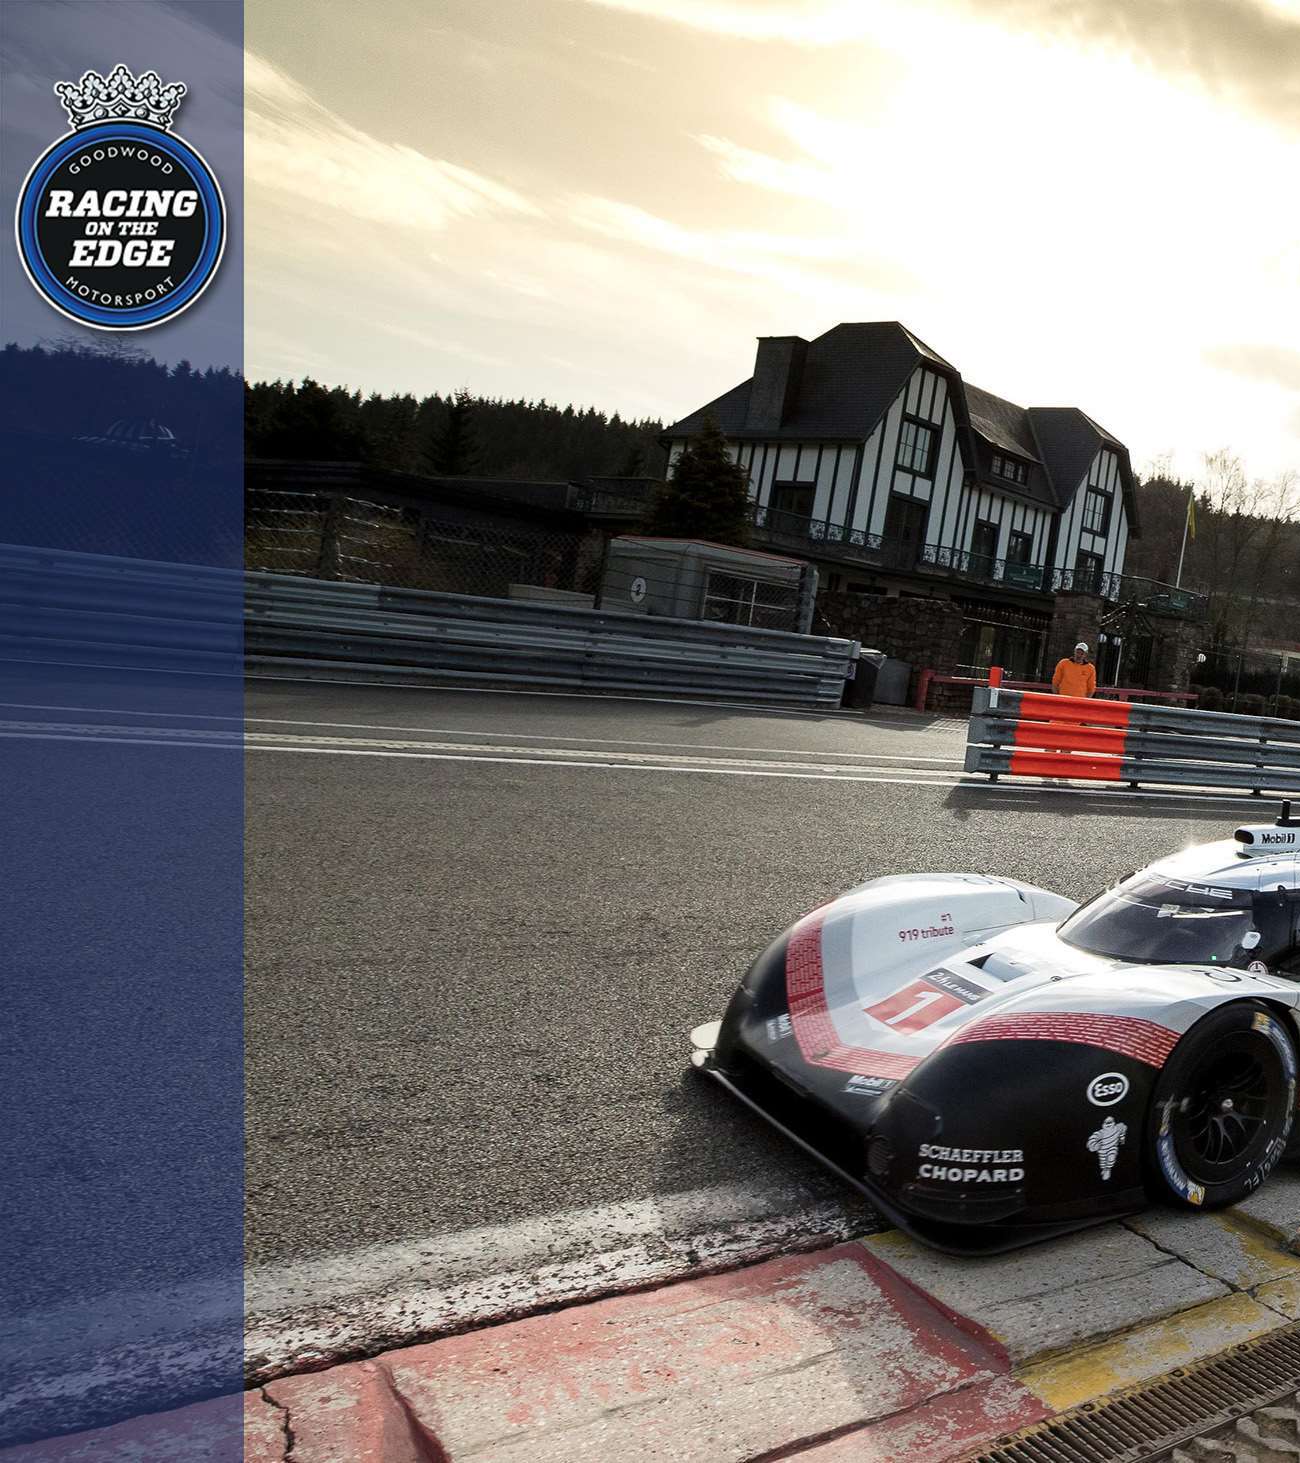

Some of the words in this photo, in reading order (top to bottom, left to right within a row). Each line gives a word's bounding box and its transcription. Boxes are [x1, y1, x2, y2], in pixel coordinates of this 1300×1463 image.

[1261, 833, 1286, 844] Mobil
[898, 929, 919, 942] 919
[921, 926, 954, 939] tribute
[884, 990, 943, 1025] 1
[1094, 1082, 1123, 1098] Esso
[918, 1144, 1024, 1163] SCHAEFFLER
[918, 1164, 1025, 1182] CHOPARD
